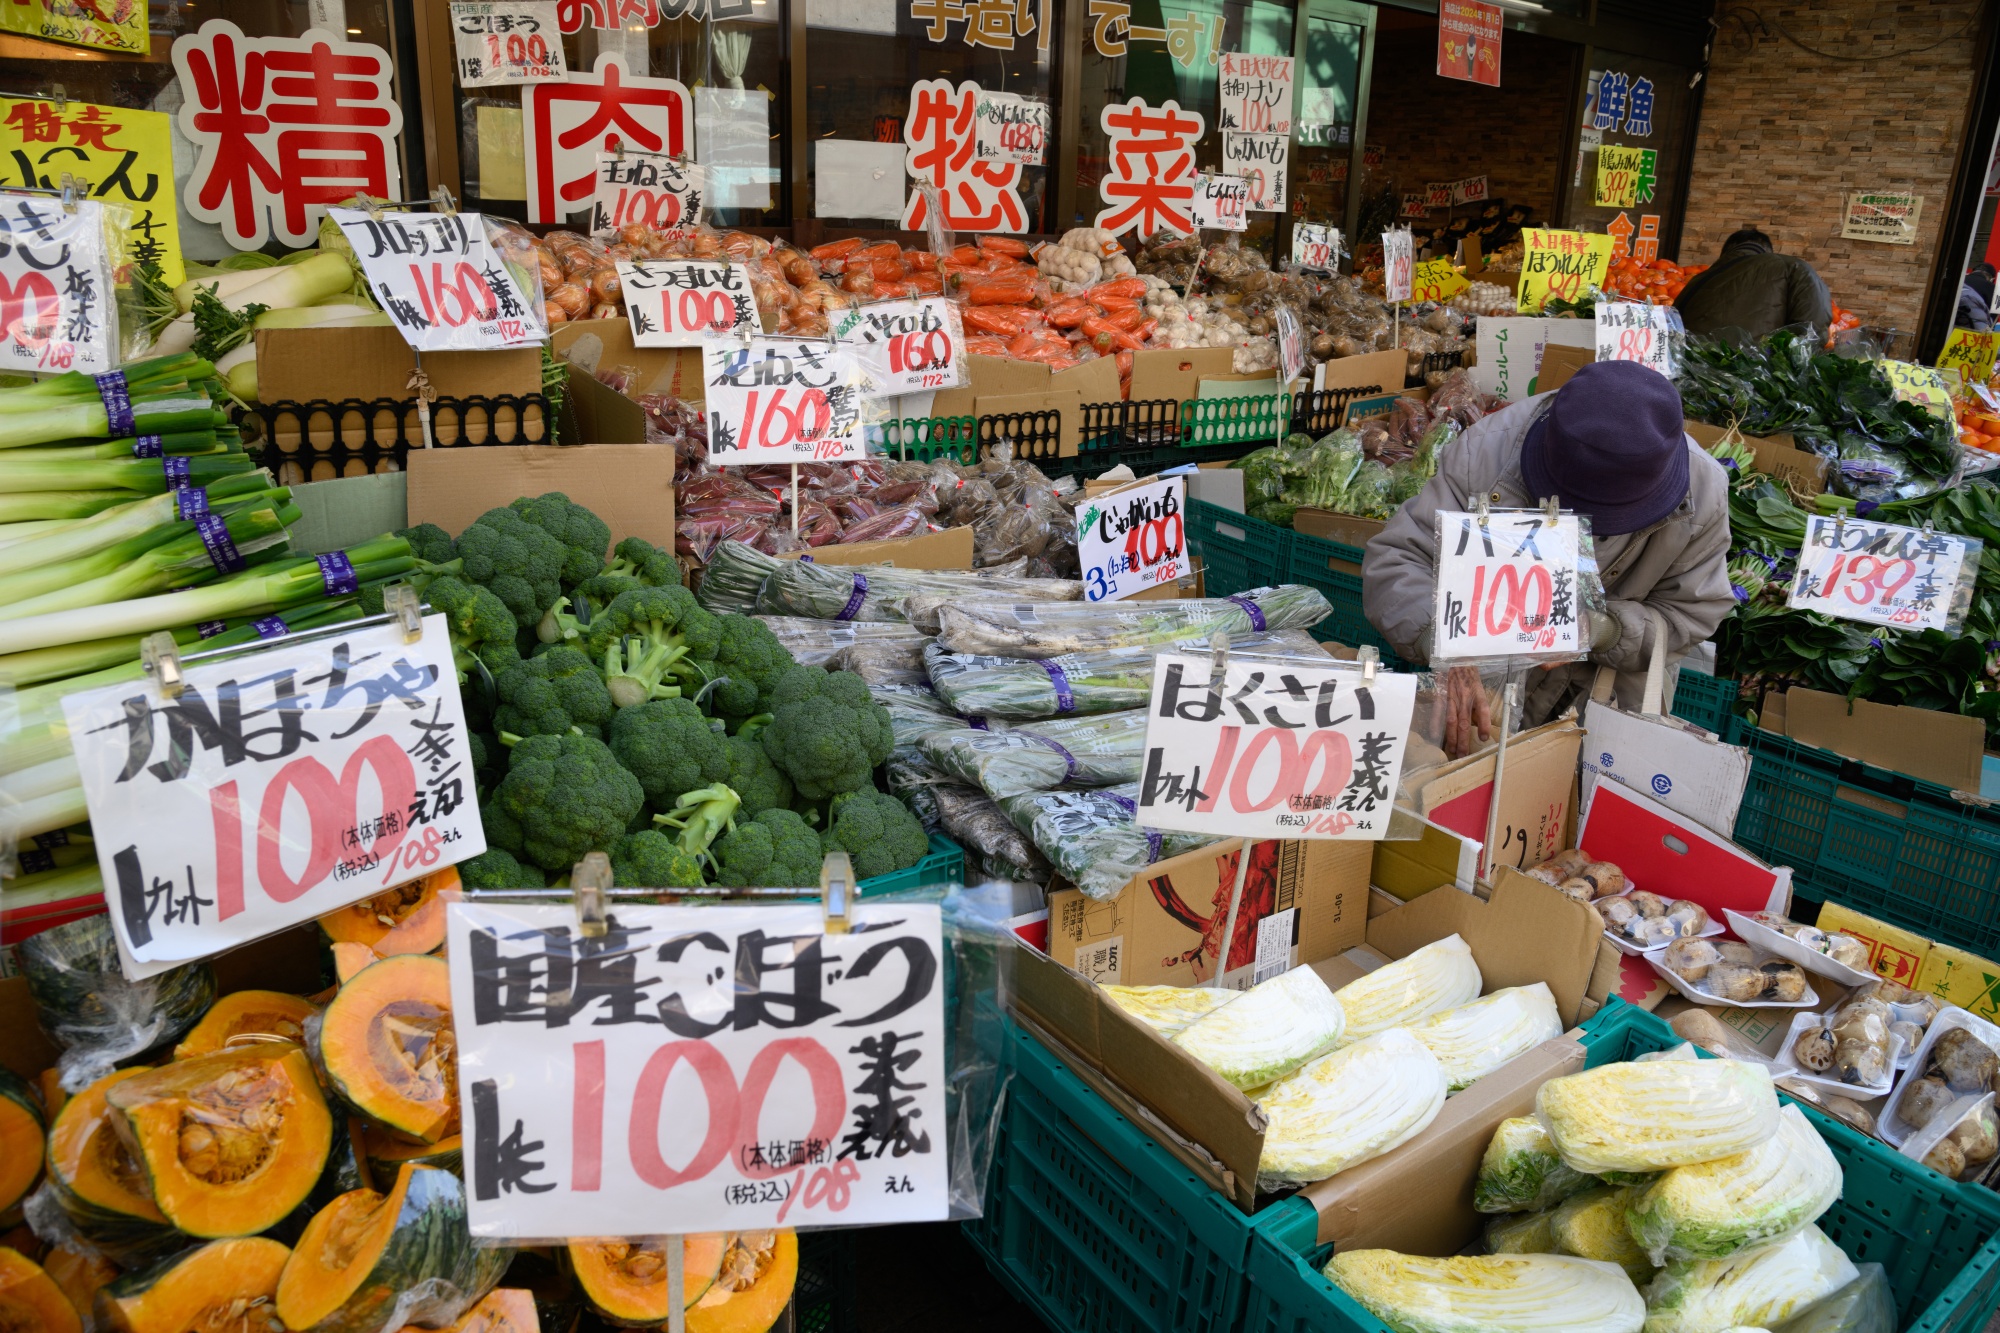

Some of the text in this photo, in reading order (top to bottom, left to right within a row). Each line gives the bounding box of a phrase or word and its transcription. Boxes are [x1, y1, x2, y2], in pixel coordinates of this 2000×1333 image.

[452, 4, 492, 14] 中国産
[459, 15, 541, 34] ごぼう
[461, 34, 560, 79] 1袋 100 えん
[523, 66, 549, 77] 108
[1241, 98, 1272, 132] 100
[1593, 70, 1654, 137] 鮮魚
[3, 102, 130, 152] 特売
[188, 33, 683, 239] 精 肉
[1001, 120, 1043, 151] 480
[602, 160, 690, 193] 玉ねぎ
[1101, 106, 1199, 237] 菜
[1603, 171, 1629, 203] 399
[611, 188, 681, 230] 100
[0, 200, 71, 270] ぎ
[341, 215, 481, 258] ブロッコリー
[1529, 231, 1590, 255] 本日特売
[1607, 211, 1660, 263] 食品
[621, 264, 743, 290] さつまいも
[1527, 251, 1603, 281] ほうれん草
[409, 261, 498, 328] 160
[661, 289, 737, 333] 100
[497, 320, 526, 340] 172
[888, 329, 952, 374] 160
[38, 343, 76, 369] 108
[922, 373, 943, 388] 172
[737, 388, 831, 450] 160
[793, 443, 814, 452] (税込)
[1100, 486, 1178, 544] じゃがいも
[1124, 512, 1184, 573] 100
[1811, 518, 1949, 565] ほうれん草
[1156, 561, 1176, 582] 108
[1820, 553, 1916, 606] 139
[1468, 564, 1553, 637] 100
[1870, 606, 1892, 615] (税込)
[1888, 607, 1919, 624] 150
[1516, 632, 1536, 643] (税込)
[1533, 627, 1557, 650] 108
[86, 642, 439, 783] かぼちゃ
[1159, 663, 1376, 729] はくさい
[1194, 725, 1353, 813] 100
[1289, 790, 1377, 812] (本体価格) えん
[209, 734, 417, 922] 100
[341, 811, 405, 852] (本体価格)
[1275, 813, 1373, 834] (税込) 108 えん
[1545, 802, 1563, 864] いちご
[333, 826, 462, 886] (税込) 108 えん
[1333, 892, 1343, 924] 3L-06
[470, 914, 937, 1039] 国産ごぼう
[1093, 948, 1108, 984] 職人
[571, 1036, 847, 1191] 100
[741, 1139, 833, 1171] (本体価格)
[725, 1158, 915, 1223] (税込) 108 えん
